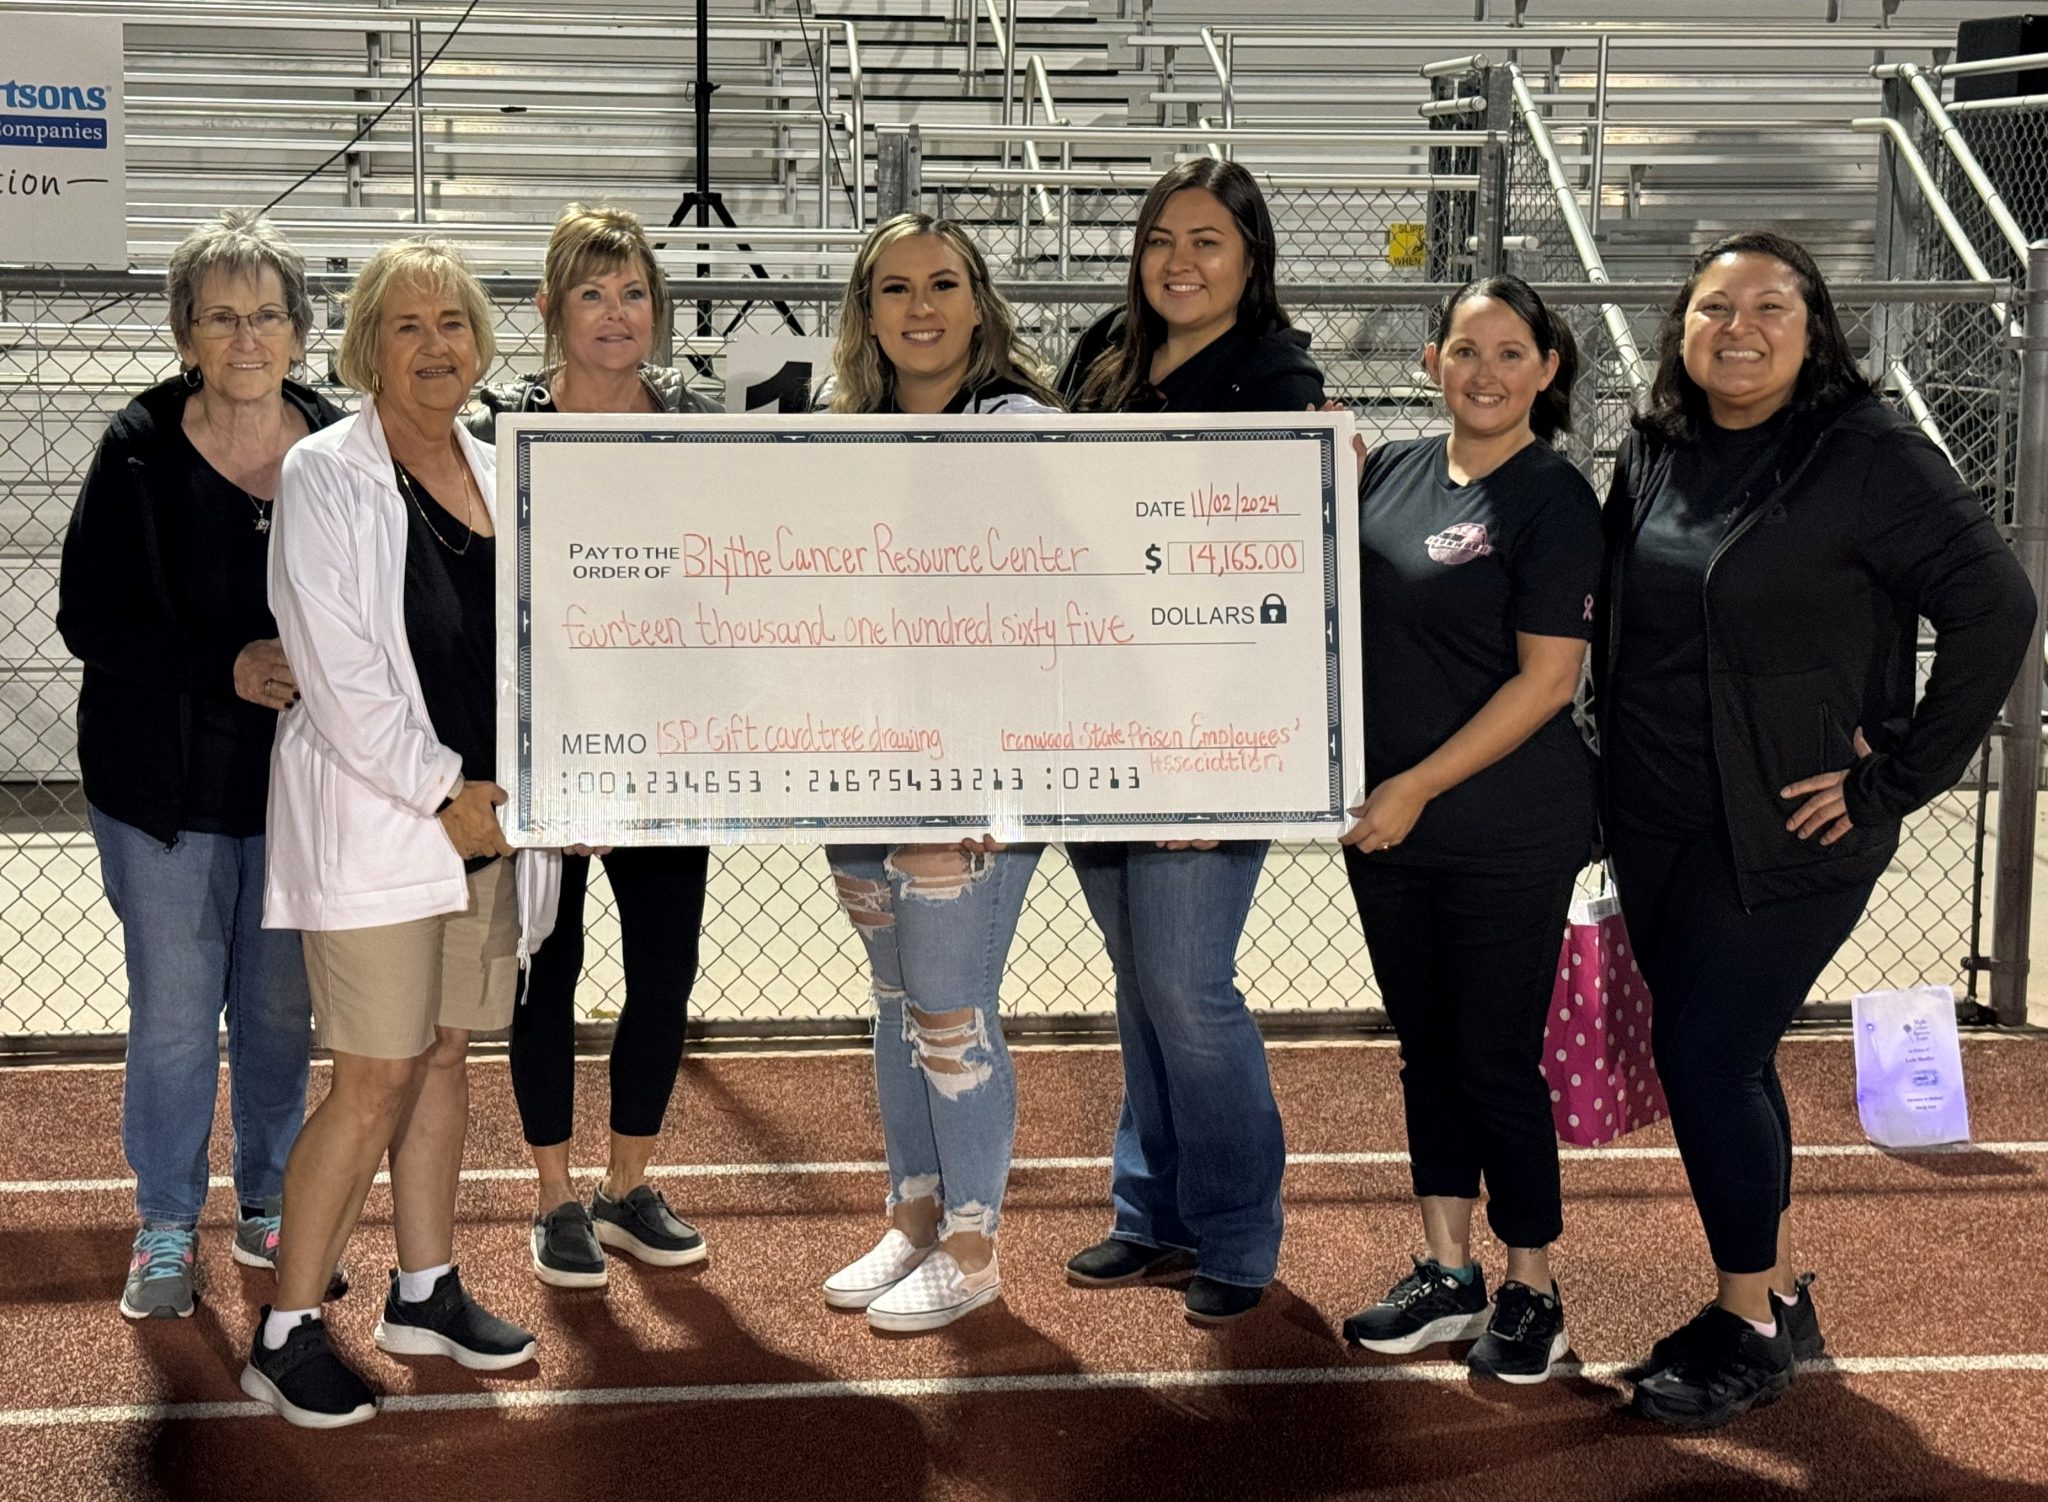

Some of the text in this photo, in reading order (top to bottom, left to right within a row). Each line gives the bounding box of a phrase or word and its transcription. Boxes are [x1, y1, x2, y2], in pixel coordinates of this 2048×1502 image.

[0, 79, 107, 111] tsons
[0, 122, 103, 144] ompanies
[1399, 224, 1425, 233] SLIPP
[1393, 256, 1421, 266] WHEN
[1135, 501, 1186, 518] DATE
[1190, 482, 1280, 526] 11/02/2024
[569, 543, 680, 560] PAY TO THE
[683, 522, 1090, 595] Blythe Cancer Resource Center
[1188, 543, 1298, 577] 14,165.00
[573, 565, 672, 579] ORDER OF
[695, 601, 836, 648] thousand
[844, 616, 888, 645] one
[892, 601, 993, 646] hundred
[1066, 600, 1134, 645] five
[1151, 606, 1255, 626] DOLLARS
[562, 733, 647, 755] MEMO
[706, 713, 759, 751] Gift
[869, 716, 944, 760] drawing
[1082, 721, 1126, 748] State
[1128, 720, 1183, 748] Prison
